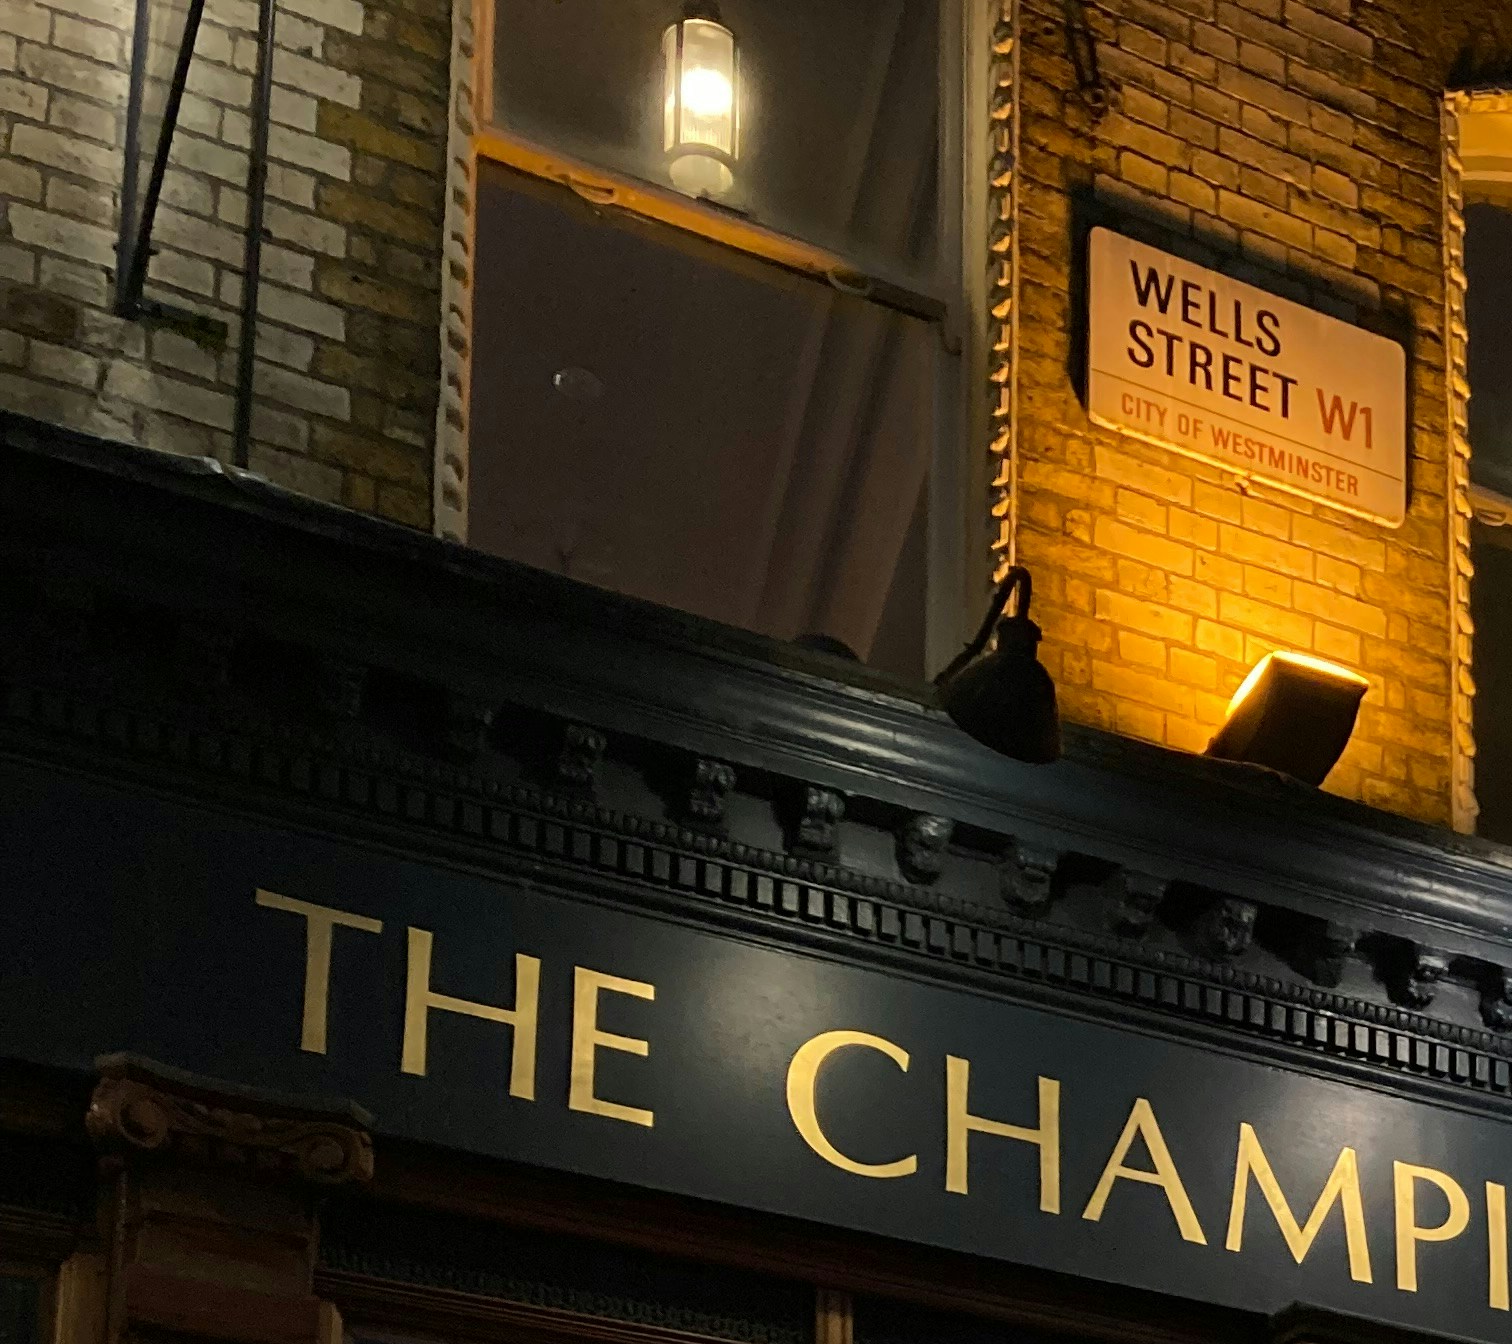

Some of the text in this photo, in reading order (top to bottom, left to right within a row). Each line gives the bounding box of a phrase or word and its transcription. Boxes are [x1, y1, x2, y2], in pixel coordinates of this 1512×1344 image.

[1130, 259, 1282, 357] WELLS
[1127, 319, 1373, 449] STREET W1
[1121, 392, 1359, 496] CITY OF WESTMINSTER
[254, 887, 656, 1128] THE
